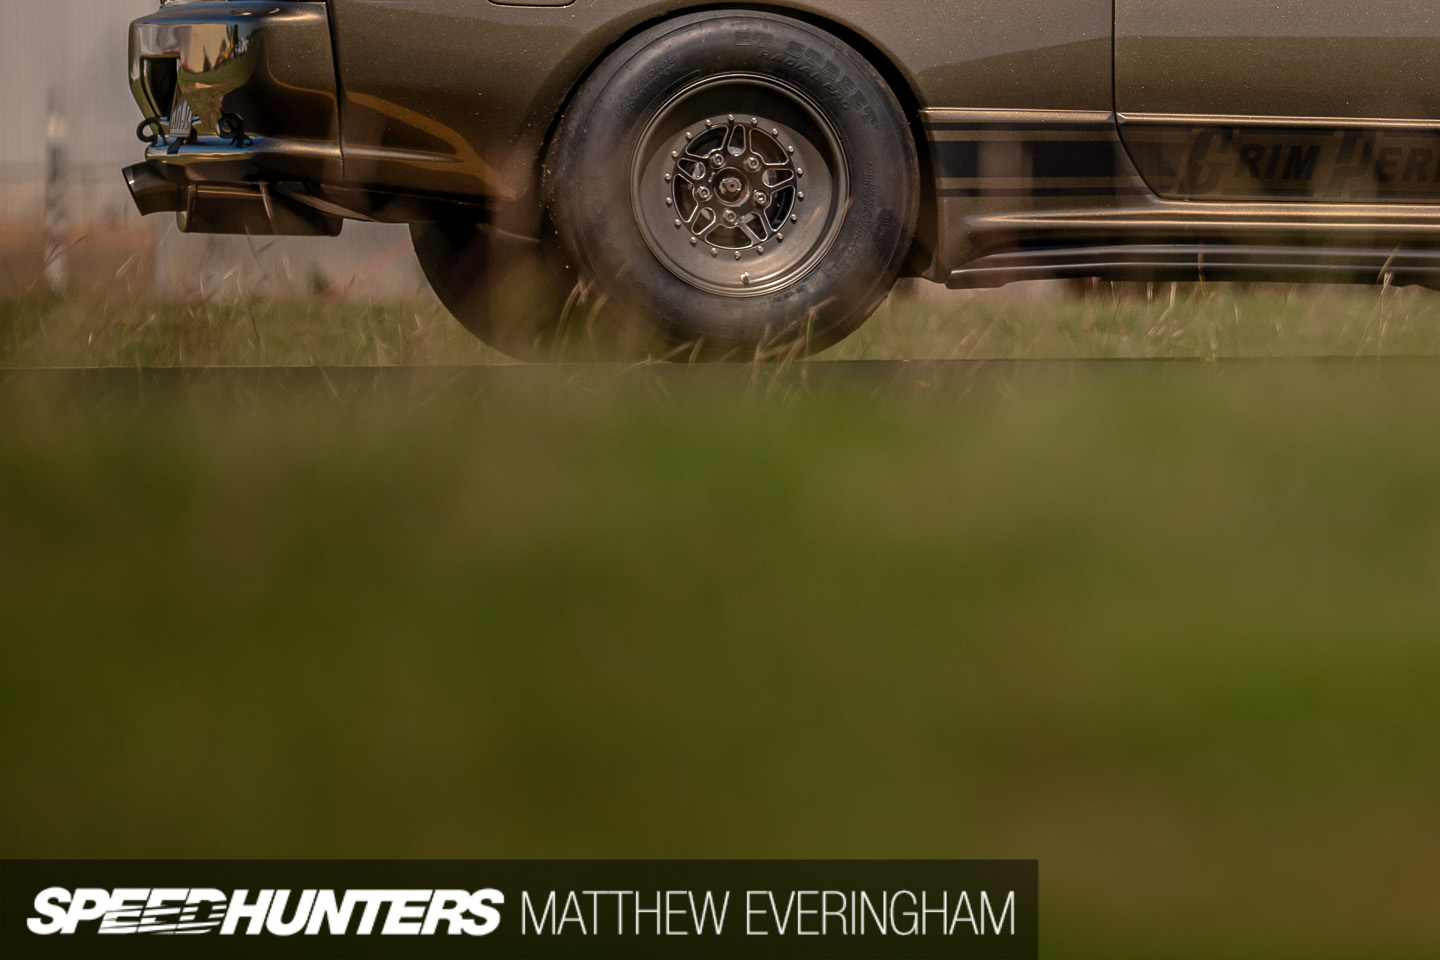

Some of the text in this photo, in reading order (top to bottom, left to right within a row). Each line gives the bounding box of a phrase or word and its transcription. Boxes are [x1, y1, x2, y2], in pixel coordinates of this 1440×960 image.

[735, 32, 879, 125] ET STREET
[758, 50, 819, 81] RADIAL
